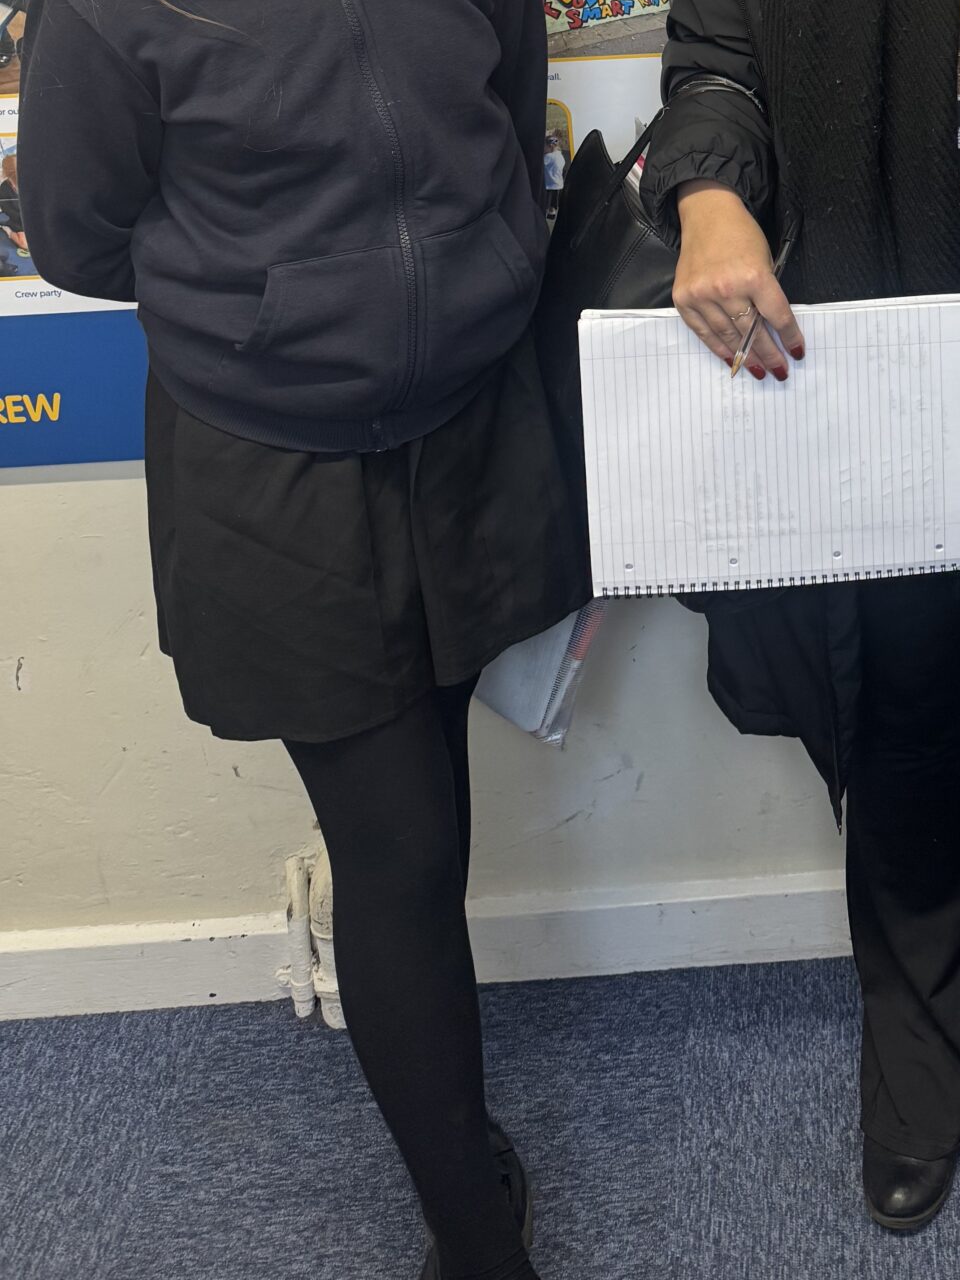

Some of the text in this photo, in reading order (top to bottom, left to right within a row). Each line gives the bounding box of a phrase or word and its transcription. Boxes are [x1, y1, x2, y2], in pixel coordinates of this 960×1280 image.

[565, 0, 635, 30] SMART
[15, 289, 61, 299] Crew party
